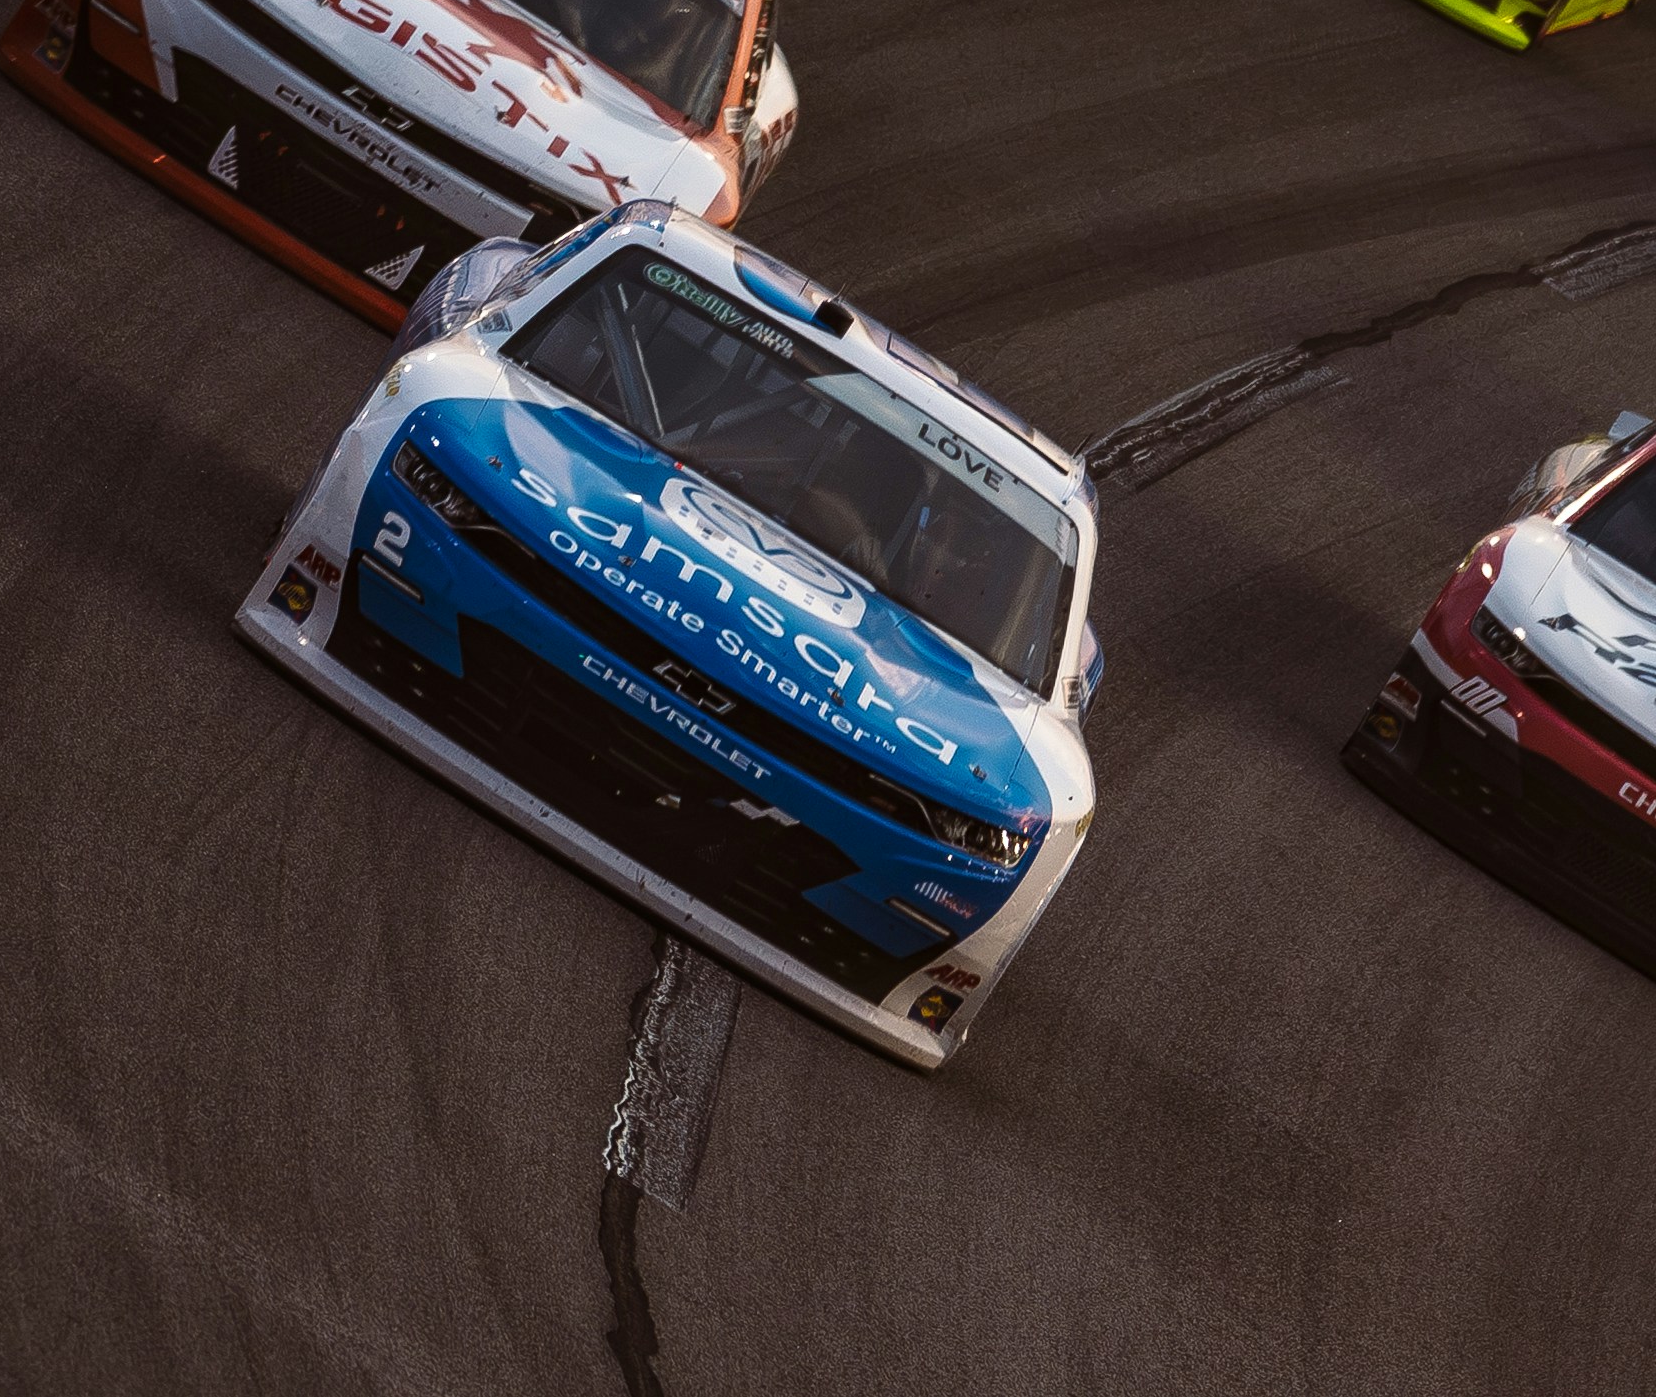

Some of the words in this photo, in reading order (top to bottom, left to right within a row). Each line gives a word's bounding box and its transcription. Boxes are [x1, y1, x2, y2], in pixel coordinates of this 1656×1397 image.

[277, 87, 436, 192] CHEVROLET
[645, 259, 747, 332] O'Reilly
[743, 324, 792, 359] PARTS
[754, 320, 795, 351] AUTO
[916, 424, 1006, 490] LOVE
[368, 511, 420, 565] 2
[511, 464, 958, 765] samsara
[549, 530, 702, 633] Operate
[585, 659, 767, 779] CHEVROLET
[1449, 668, 1507, 721] 00
